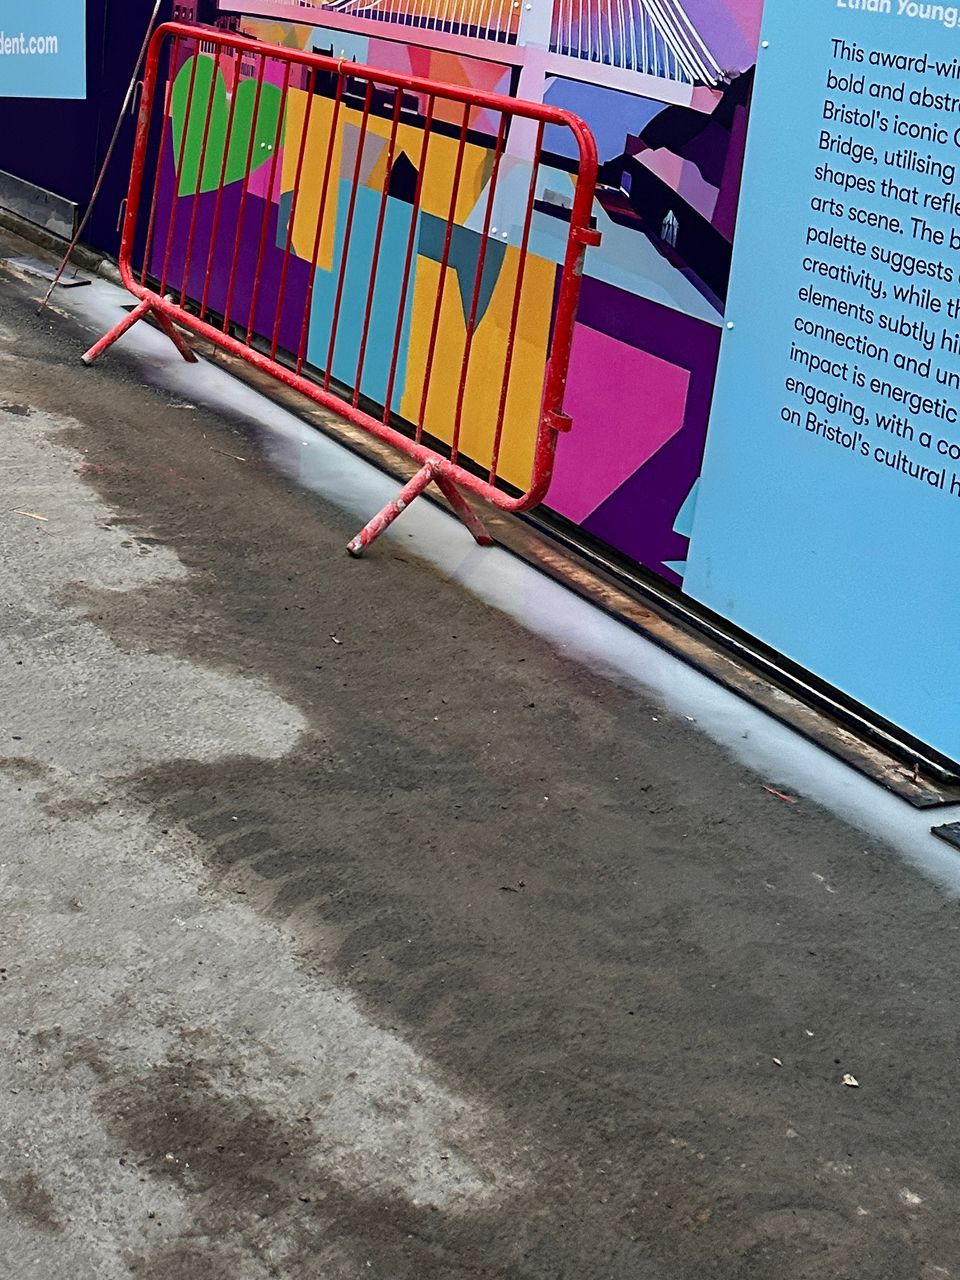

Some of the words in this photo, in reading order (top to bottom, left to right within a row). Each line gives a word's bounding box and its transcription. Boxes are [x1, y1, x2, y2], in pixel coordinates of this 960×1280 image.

[831, 38, 865, 62] This
[826, 69, 865, 94] bold
[869, 82, 905, 102] and
[909, 86, 960, 112] abstr
[823, 100, 889, 132] Bristol's
[893, 114, 948, 145] iconic
[814, 162, 876, 194] shapes
[881, 178, 918, 205] that
[819, 130, 878, 165] Bridge,
[884, 149, 955, 185] utilising
[810, 196, 844, 217] arts
[848, 206, 904, 235] scene.
[911, 216, 945, 245] The
[806, 226, 866, 256] palette
[870, 245, 953, 282] suggests
[802, 257, 887, 299] creativity,
[893, 284, 941, 313] while
[794, 317, 889, 363] connection
[893, 353, 932, 378] and
[798, 284, 874, 324] elements
[878, 314, 936, 351] subtly
[940, 328, 960, 355] hi
[789, 341, 849, 381] impact
[852, 365, 866, 387] is
[870, 378, 958, 423] energetic
[785, 377, 869, 426] engaging,
[875, 413, 914, 441] with
[919, 432, 932, 449] a
[780, 407, 801, 427] on
[805, 411, 870, 456] Bristol's
[874, 450, 946, 490] cultural
